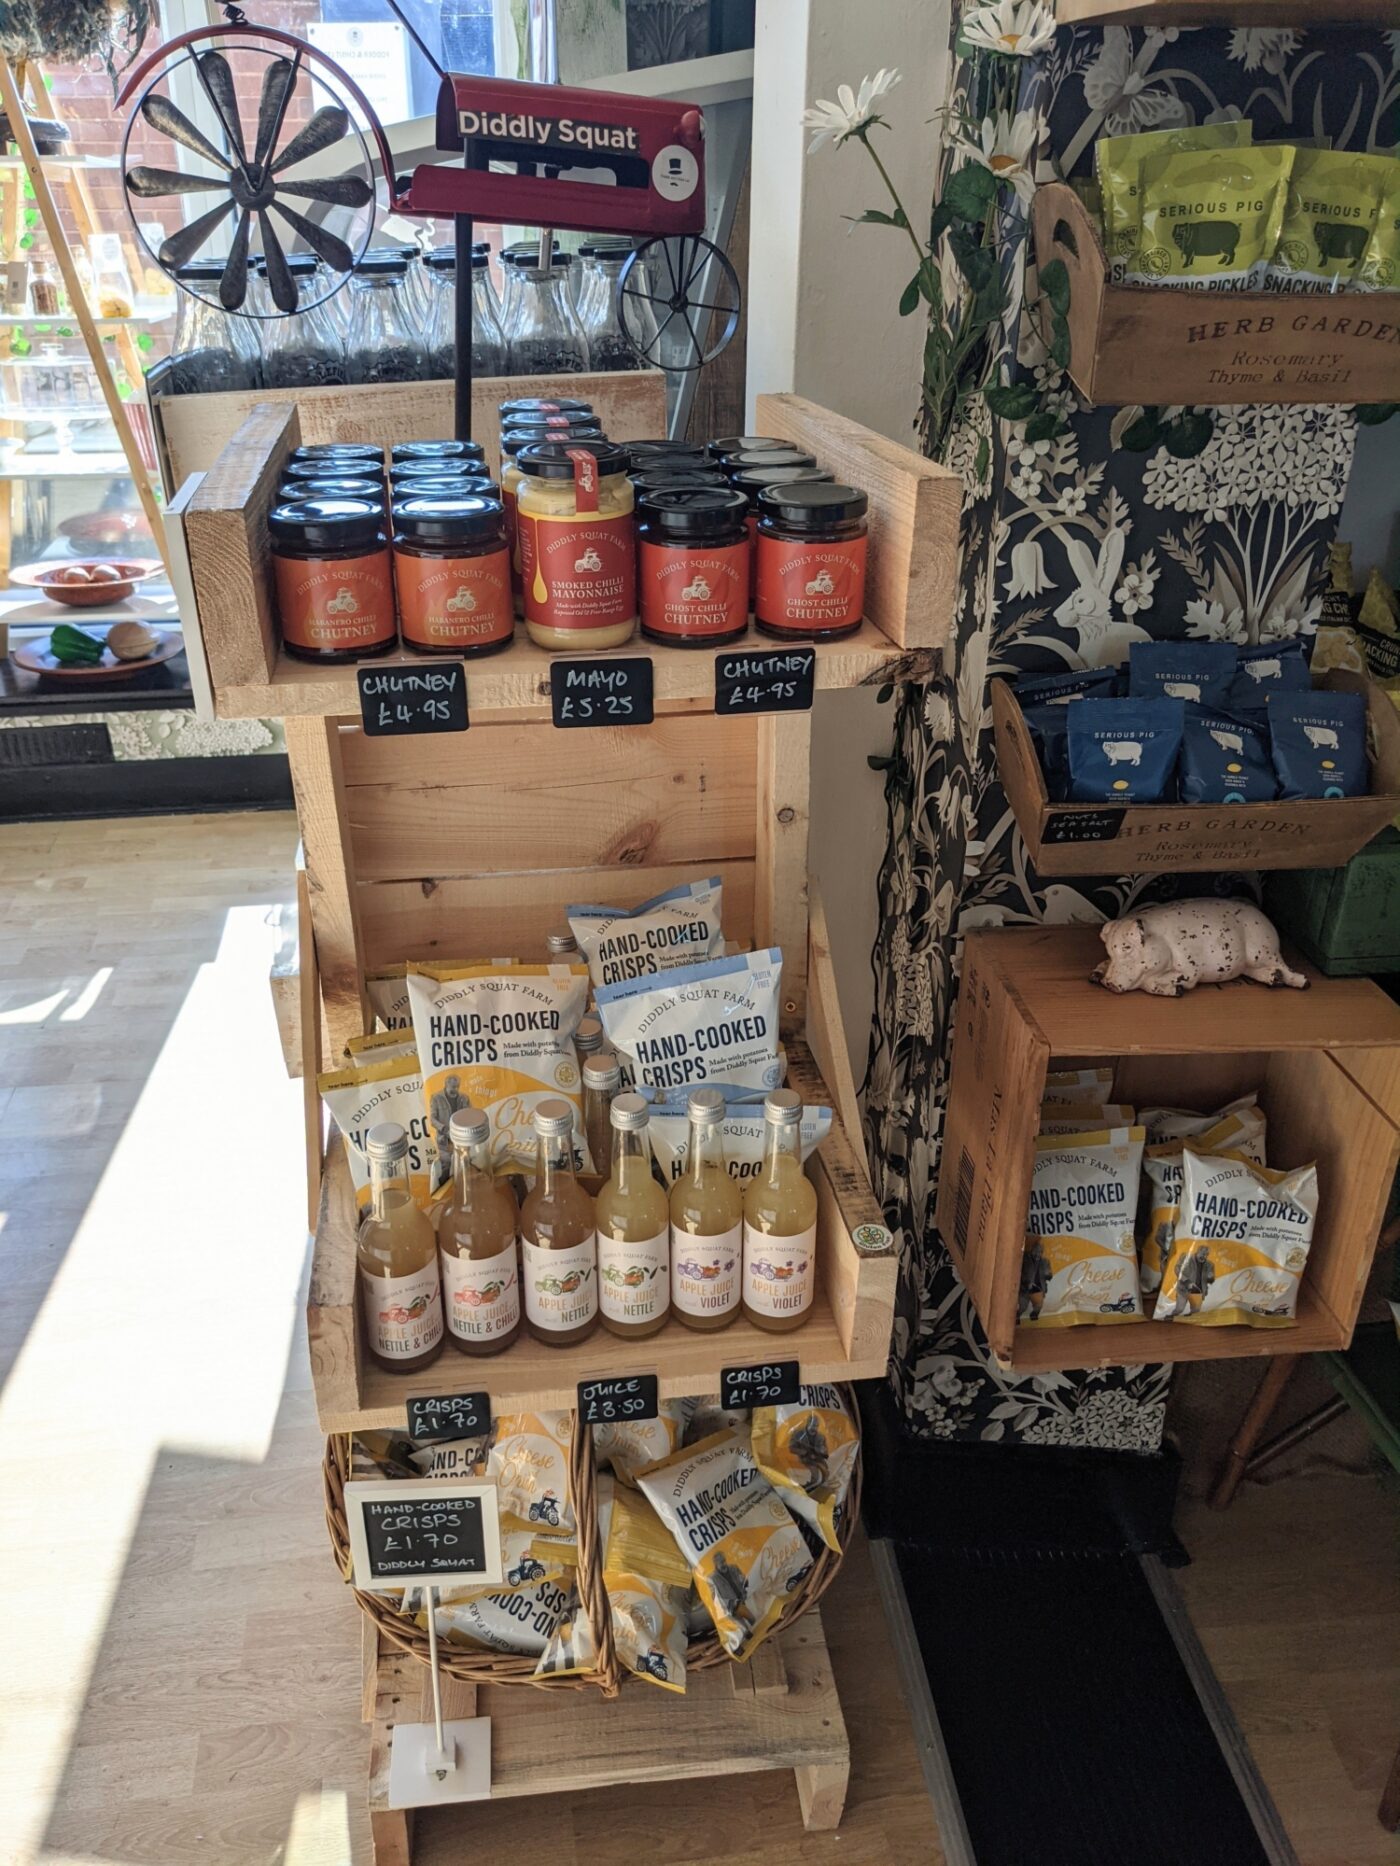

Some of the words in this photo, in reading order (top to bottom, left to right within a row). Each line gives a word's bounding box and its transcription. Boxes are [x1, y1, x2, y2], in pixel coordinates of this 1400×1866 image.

[458, 110, 551, 144] Diddly
[558, 118, 637, 150] Squat
[1159, 202, 1227, 218] SERIOUS
[1235, 200, 1264, 212] PIG
[1302, 202, 1361, 219] SERIOUS
[1208, 269, 1259, 292] PICKLES
[1186, 316, 1275, 343] HERB
[1208, 369, 1263, 385] Thyme
[1273, 369, 1285, 383] &
[1296, 369, 1352, 384] Basil
[546, 532, 577, 554] DIDDLY
[580, 531, 608, 542] SQUAT
[609, 534, 627, 553] FARM
[656, 561, 687, 581] DIDDLY
[689, 560, 720, 570] SQUAT
[721, 563, 740, 582] FARM
[779, 556, 812, 576] DIDDLY
[815, 553, 844, 562] SQUAT
[296, 572, 328, 595] DIDDLY
[332, 571, 363, 580] SQUAT
[417, 571, 449, 593] DIDDLY
[452, 569, 483, 579] SQUAT
[485, 571, 504, 589] FARM
[552, 580, 593, 590] SMOKED
[595, 576, 624, 589] CHILLI
[552, 584, 624, 599] MAYONNAISE
[664, 603, 696, 612] GHOST
[697, 603, 727, 612] CHILLI
[787, 598, 819, 607] GHOST
[820, 597, 848, 606] CHILLI
[308, 615, 349, 627] HABANERO
[352, 613, 377, 625] CHILLI
[428, 614, 469, 625] HABANERO
[471, 612, 496, 624] CHILLI
[664, 612, 728, 625] CHUTNEY
[786, 606, 849, 619] CHUTNEY
[310, 623, 377, 640] CHUTNEY
[430, 621, 496, 638] CHUTNEY
[1364, 643, 1398, 667] ACKING
[723, 655, 812, 679] CHUTNEY
[363, 671, 457, 694] CHUTNEY
[566, 669, 628, 689] MAYO
[1155, 673, 1192, 682] SERIOUS
[1194, 674, 1210, 682] PIG
[729, 682, 796, 706] £4.95
[378, 700, 451, 726] £4.95
[561, 696, 633, 720] £5.25
[1200, 720, 1236, 731] SERIOUS
[1292, 717, 1328, 726] SERIOUS
[1330, 719, 1344, 727] PIG
[1094, 731, 1135, 740] SERIOUS
[1138, 731, 1155, 739] PIG
[1117, 820, 1192, 838] HERB
[1206, 819, 1313, 836] GARDEN
[1136, 851, 1184, 863] Thyme
[1192, 851, 1203, 861] &
[599, 920, 709, 962] HAND-COOKED
[659, 953, 675, 963] Made
[676, 952, 688, 961] with
[660, 961, 675, 971] from
[675, 957, 693, 969] Diddly
[602, 953, 658, 986] CRISPS
[757, 980, 770, 988] FREE
[434, 985, 476, 1009] DIDDLY
[480, 983, 519, 992] SQUAT
[522, 986, 554, 1006] FARM
[638, 997, 677, 1034] DIDDLY
[680, 989, 720, 1003] SQUAT
[723, 991, 756, 1010] FARM
[430, 1010, 560, 1039] HAND-COOKED
[503, 1041, 521, 1050] Made
[522, 1040, 536, 1049] with
[636, 1015, 767, 1065] HAND-COOKED
[432, 1038, 498, 1068] CRISPS
[503, 1051, 520, 1059] from
[520, 1048, 543, 1058] Diddly
[709, 1057, 726, 1067] Made
[727, 1054, 742, 1063] with
[643, 1056, 707, 1089] CRISPS
[710, 1065, 726, 1075] from
[726, 1060, 747, 1073] Diddly
[748, 1056, 767, 1068] Squat
[351, 1088, 392, 1124] DIDDLY
[723, 1126, 764, 1138] SQUAT
[984, 1143, 997, 1173] La
[1055, 1155, 1087, 1164] SQUAT
[1090, 1159, 1118, 1177] FARM
[1205, 1168, 1243, 1188] DIDDLY
[1031, 1182, 1125, 1210] AND-COOKED
[1195, 1192, 1308, 1225] HAND-COOKED
[1091, 1220, 1109, 1228] Diddly
[1191, 1214, 1247, 1239] CRISPS
[1261, 1232, 1280, 1241] Diddly
[1067, 1261, 1125, 1288] Cheese
[1230, 1269, 1288, 1294] Cheese
[603, 1285, 630, 1302] APPLE
[633, 1286, 659, 1302] JUICE
[680, 1279, 707, 1297] APPLE
[710, 1279, 735, 1297] JUICE
[752, 1279, 780, 1297] APPLE
[782, 1279, 808, 1297] JUICE
[538, 1297, 568, 1310] APPLE
[570, 1291, 594, 1307] JUICE
[623, 1302, 655, 1316] NETTLE
[701, 1291, 730, 1309] VIOLET
[772, 1294, 803, 1310] VIOLET
[453, 1306, 479, 1322] APPLE
[485, 1302, 510, 1320] JUICE
[561, 1305, 590, 1323] NETTLE
[378, 1326, 407, 1341] APPLE
[411, 1318, 434, 1335] JUICE
[453, 1320, 483, 1334] NETTLE
[486, 1322, 492, 1333] &
[379, 1337, 410, 1352] NETTLE
[413, 1339, 421, 1350] &
[726, 1366, 783, 1385] CRISPS
[584, 1379, 641, 1398] JUICE
[729, 1385, 782, 1405] £1.70
[799, 1384, 840, 1410] CRISPS
[413, 1397, 473, 1415] CRISPS
[586, 1399, 646, 1421] £3.50
[414, 1413, 478, 1434] £1.70
[505, 1436, 556, 1469] Cheese
[673, 1462, 697, 1498] DIDDLY
[698, 1448, 726, 1466] SQUAT
[728, 1447, 754, 1464] FARM
[676, 1467, 758, 1527] HAND-COOKED
[371, 1500, 476, 1515] HAND-COOKED
[381, 1513, 462, 1530] CRISPS
[689, 1508, 735, 1552] CRISPS
[384, 1534, 458, 1552] £1.70
[432, 1558, 476, 1569] SQUAT
[760, 1537, 800, 1581] Cheese
[535, 1581, 567, 1613] SPS
[469, 1601, 488, 1630] FARM
